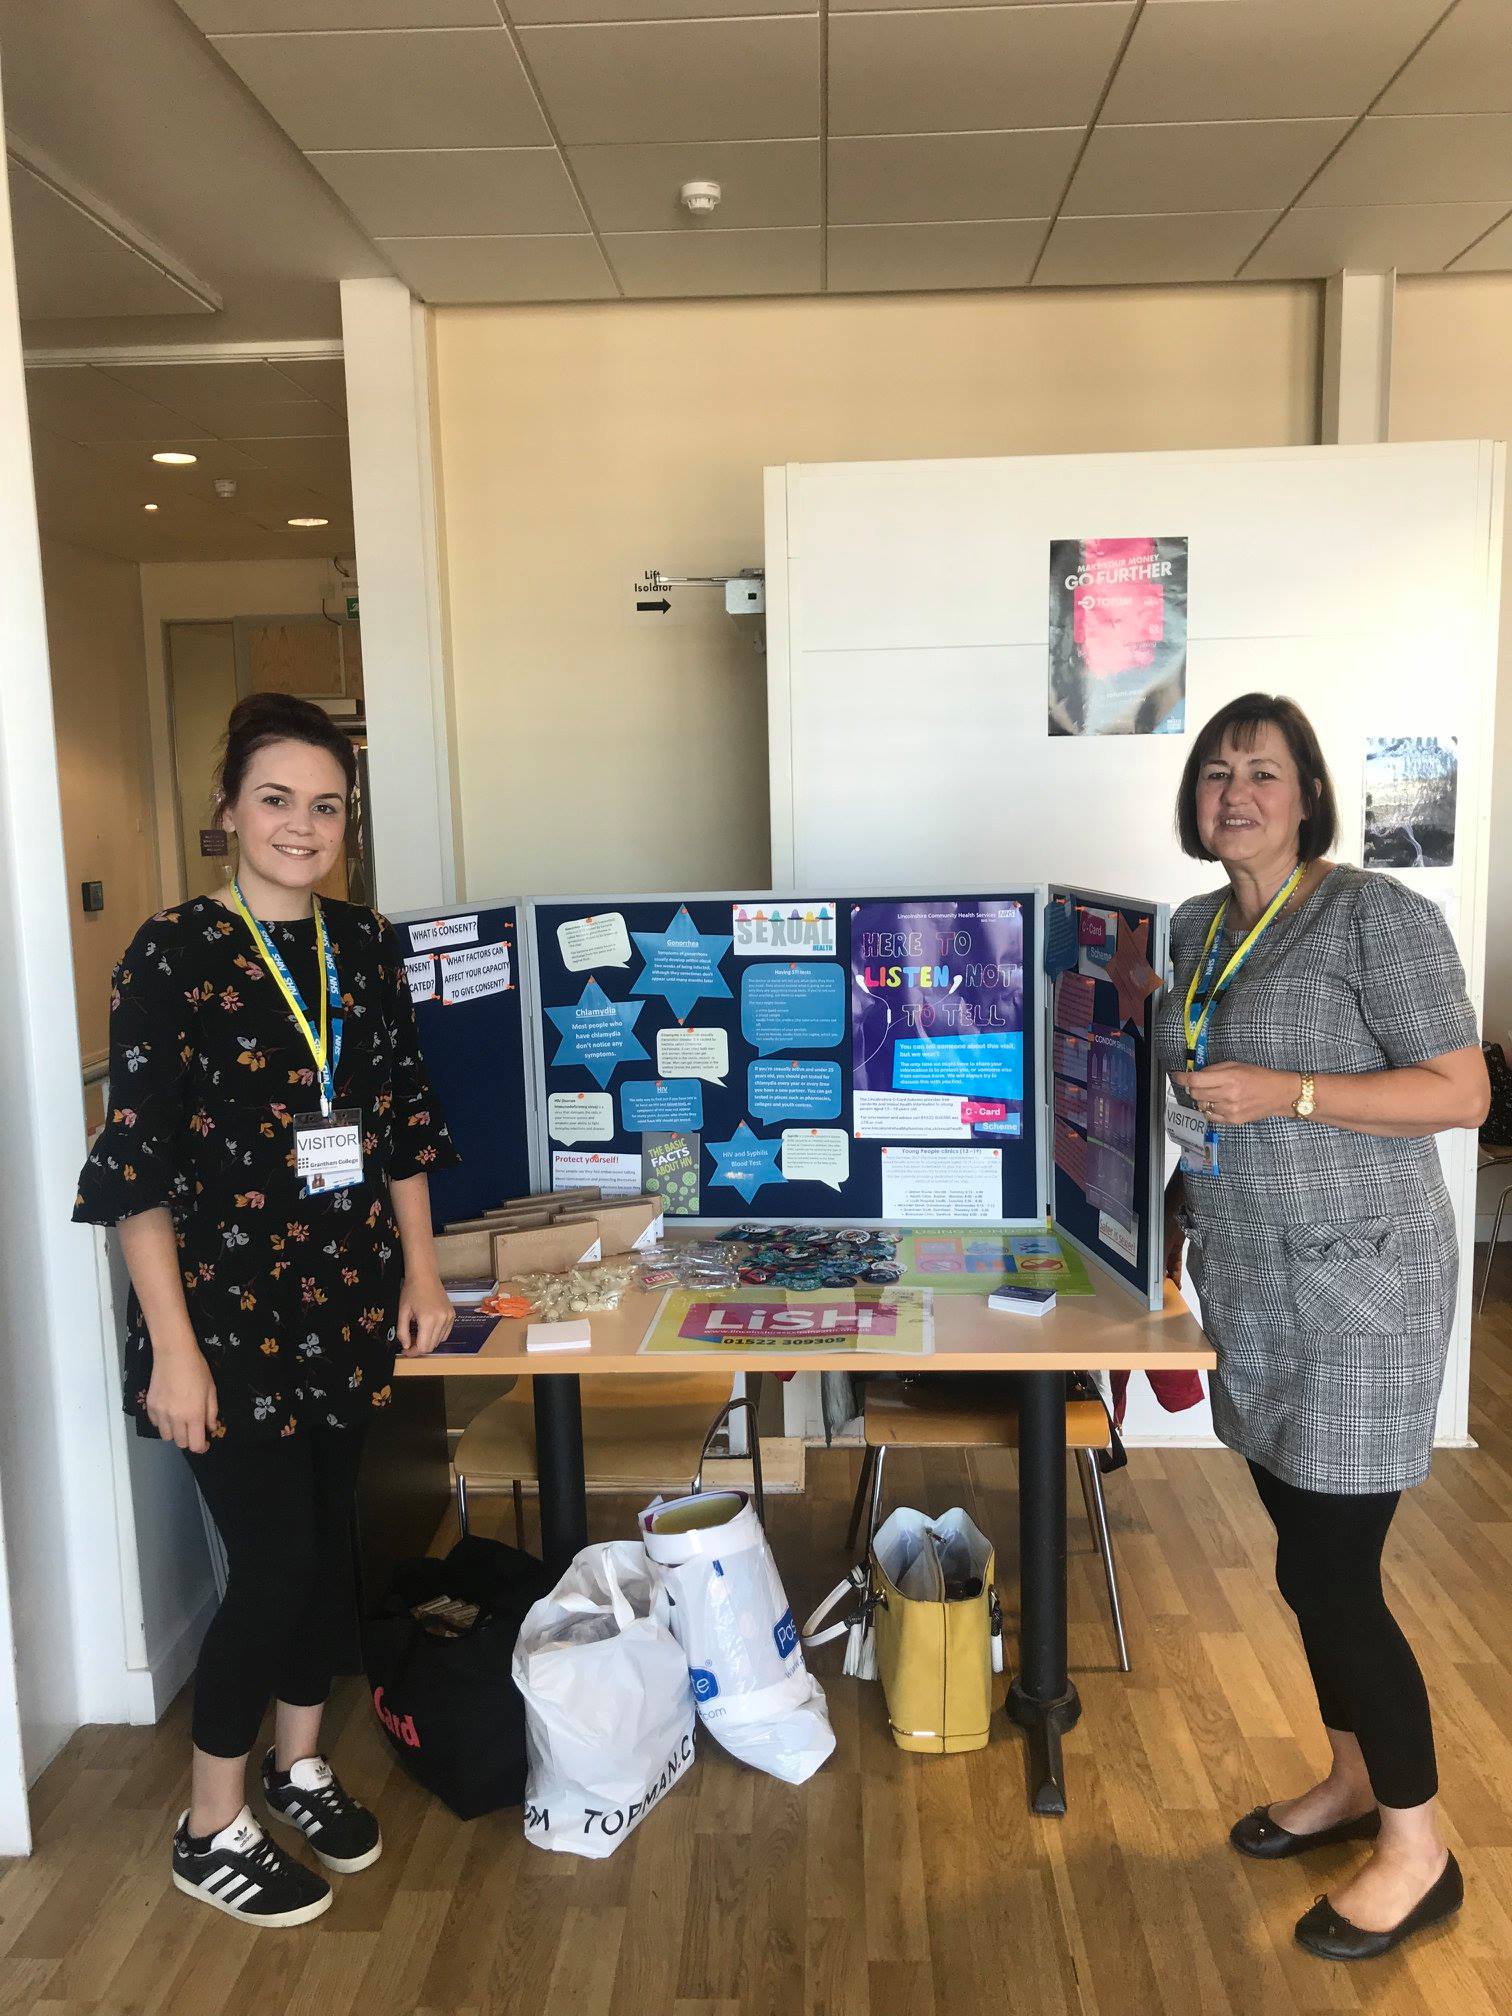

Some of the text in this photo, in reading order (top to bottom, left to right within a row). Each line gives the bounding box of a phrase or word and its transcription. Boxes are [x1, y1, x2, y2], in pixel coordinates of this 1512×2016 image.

[1128, 554, 1159, 565] MONEY
[1065, 562, 1172, 590] GO FURTHER
[412, 922, 477, 940] WHAT IS CONSENT?
[737, 920, 833, 946] SEXUAL
[862, 931, 971, 957] HERE TO
[272, 953, 286, 971] NHS
[326, 952, 335, 970] NHS
[446, 946, 504, 966] WHAT FACTORS CAN
[445, 961, 510, 983] AFFECT YOUR CAPACITY
[864, 963, 1016, 987] LISTEN NOT
[1206, 958, 1214, 975] NHS
[284, 977, 299, 995] NHS
[330, 976, 339, 994] NHS
[452, 978, 504, 999] TO GIVE CONSENT?
[576, 1007, 616, 1017] Chlamydia
[902, 1004, 1006, 1027] TO TELL
[591, 1031, 621, 1039] chlamydia
[983, 1122, 1017, 1130] Scheme
[1168, 1110, 1204, 1134] VISITOR
[298, 1134, 357, 1151] VISITOR
[648, 1138, 686, 1157] THE BASIC
[585, 1156, 618, 1164] yourself!
[651, 1147, 690, 1167] FACTS
[747, 1150, 767, 1158] Syphilis
[656, 1156, 692, 1176] ABOUT HIV
[705, 1309, 873, 1330] LiSH
[782, 1336, 846, 1345] 309309
[374, 1686, 421, 1748] Card
